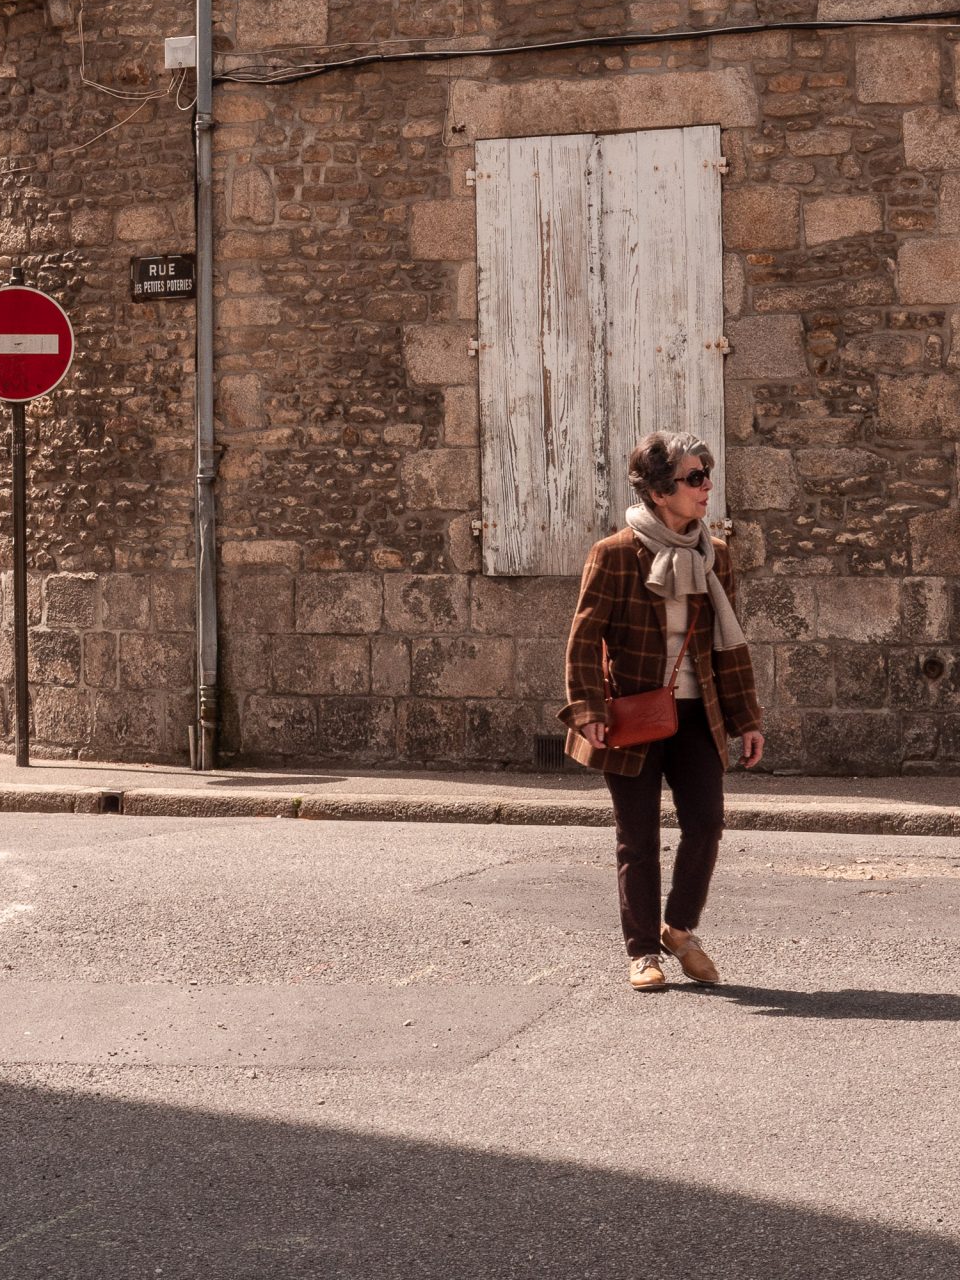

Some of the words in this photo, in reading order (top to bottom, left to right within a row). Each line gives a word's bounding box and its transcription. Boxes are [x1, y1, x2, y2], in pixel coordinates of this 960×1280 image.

[149, 263, 175, 276] RUE
[144, 280, 165, 293] PETITES
[167, 279, 193, 292] POTERIES
